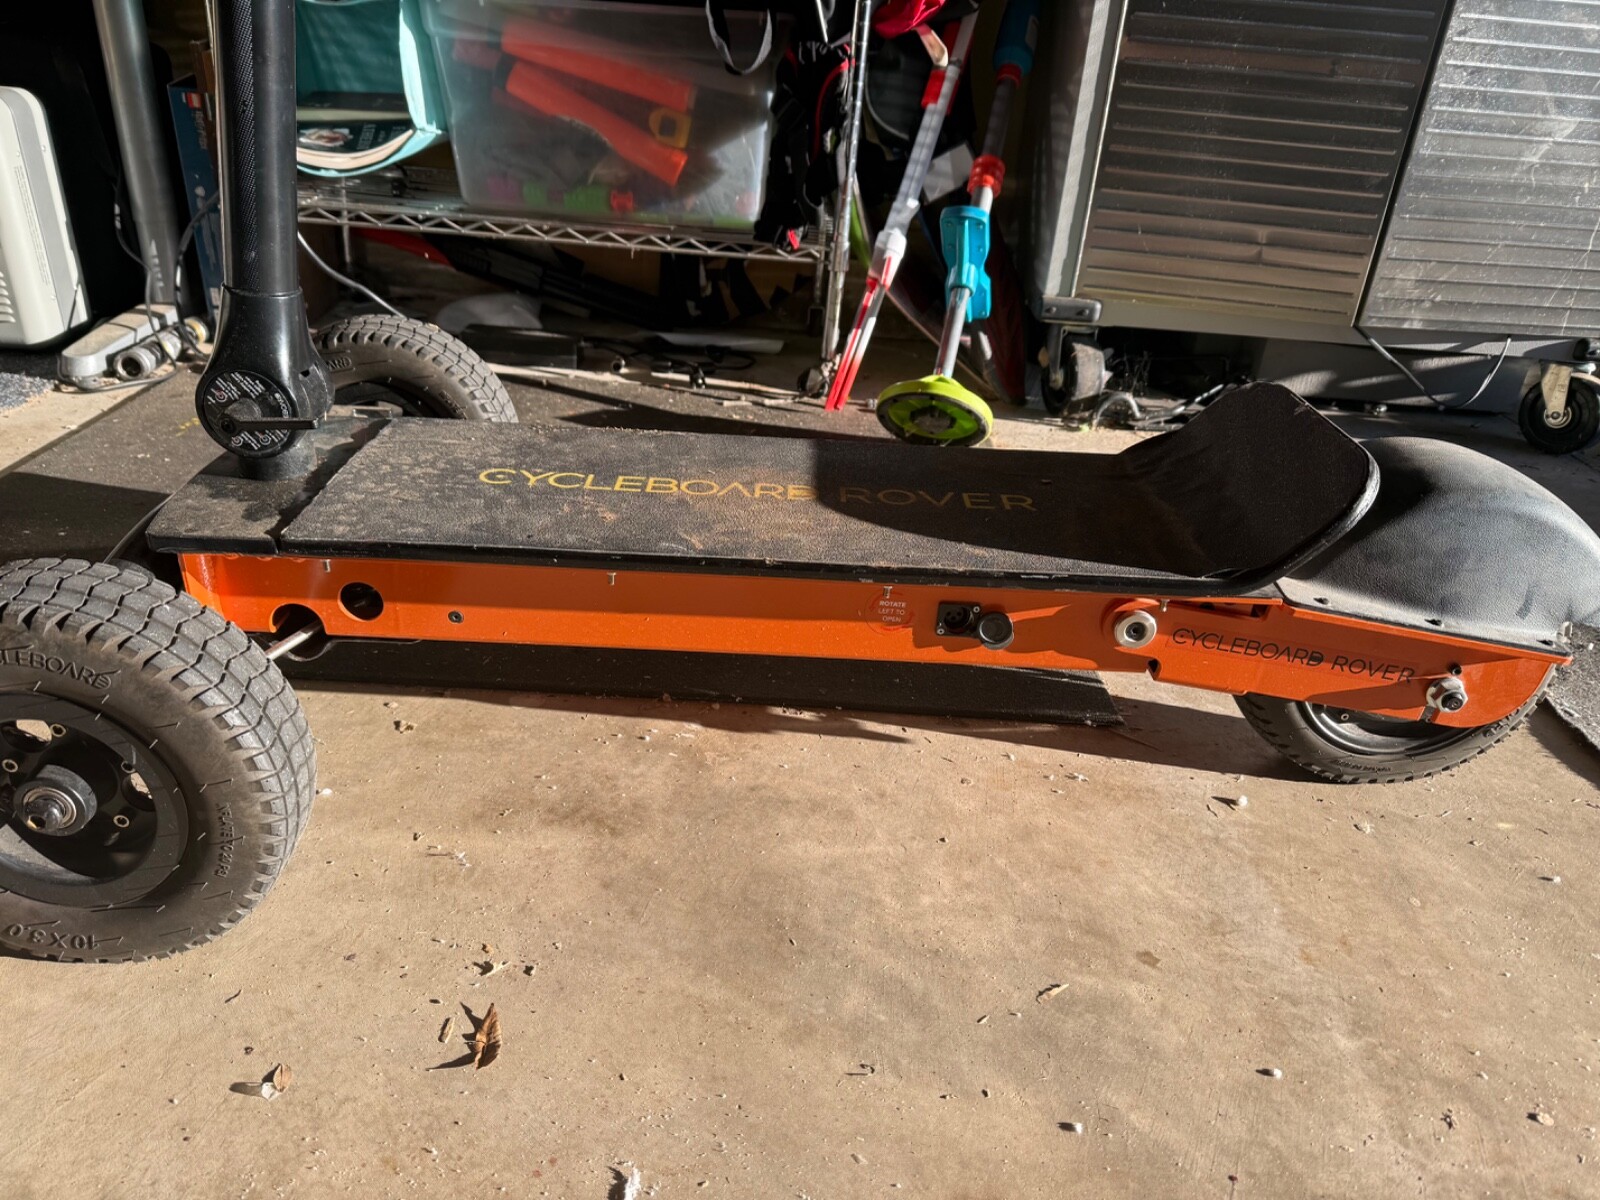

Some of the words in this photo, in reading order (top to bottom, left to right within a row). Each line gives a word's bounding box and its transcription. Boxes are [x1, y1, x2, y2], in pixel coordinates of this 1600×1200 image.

[478, 467, 817, 501] CYCLEBOARD
[840, 486, 1038, 511] ROVER
[879, 600, 907, 608] ROTATE
[1172, 627, 1324, 667] CYCLEBOARD
[1331, 655, 1416, 684] ROVER
